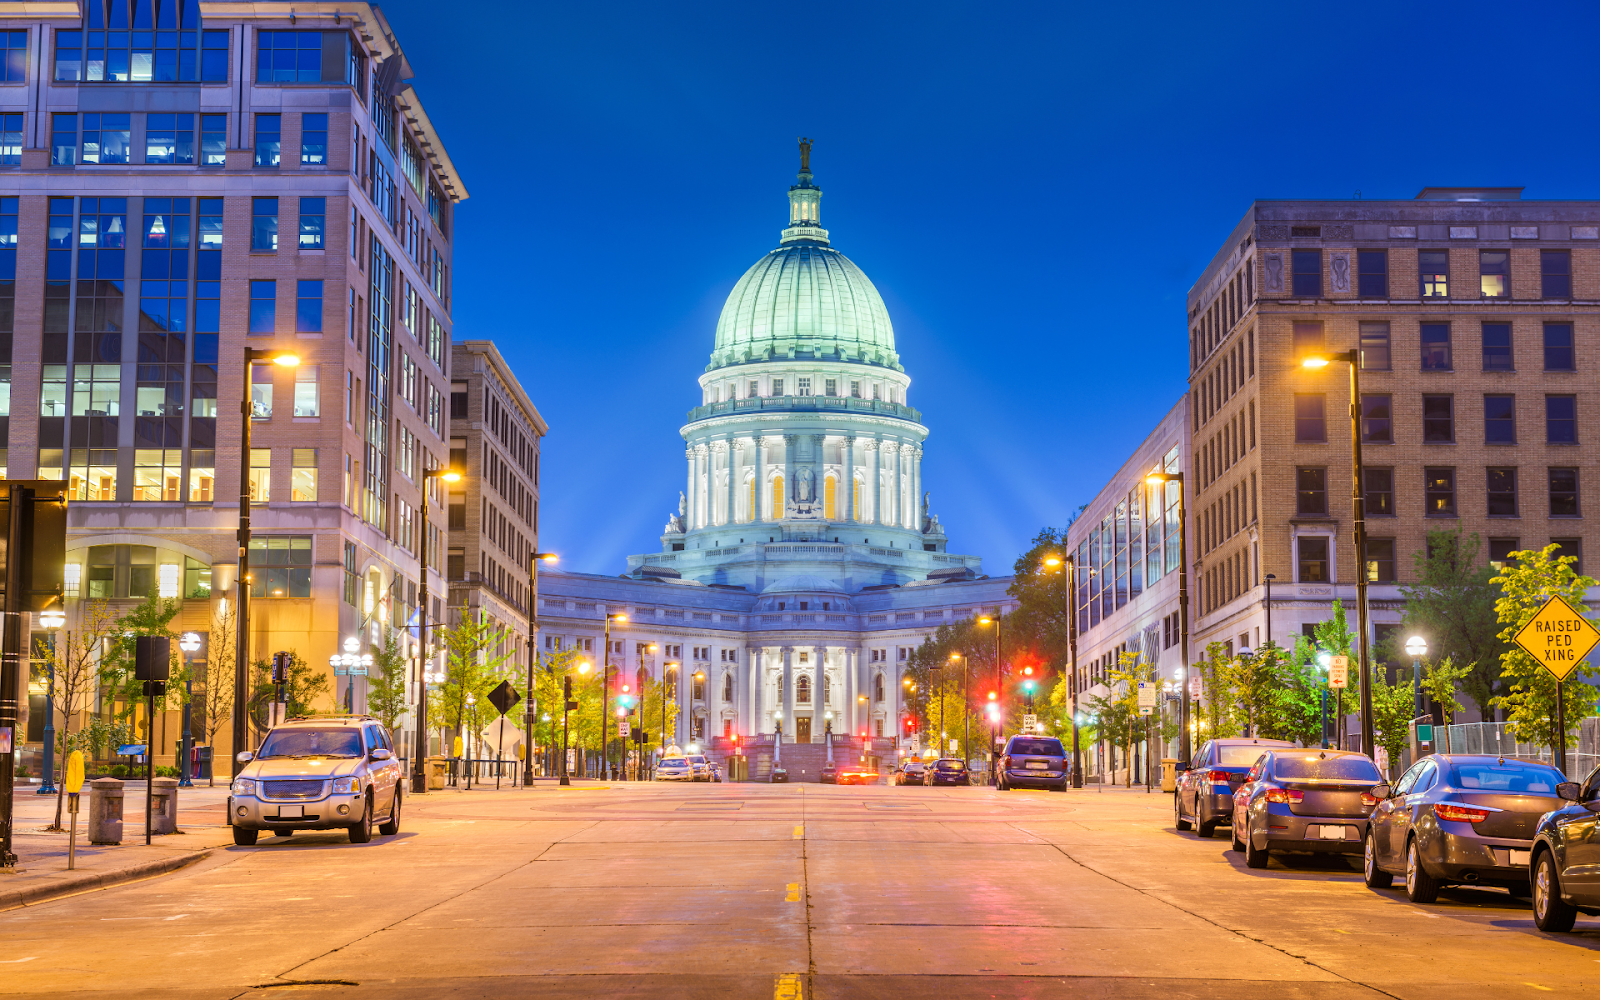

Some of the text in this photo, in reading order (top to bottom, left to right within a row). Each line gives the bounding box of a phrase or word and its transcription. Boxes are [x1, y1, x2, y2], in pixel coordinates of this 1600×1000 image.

[1536, 620, 1581, 632] RAISED
[1547, 635, 1571, 646] PED
[1544, 649, 1574, 661] XING
